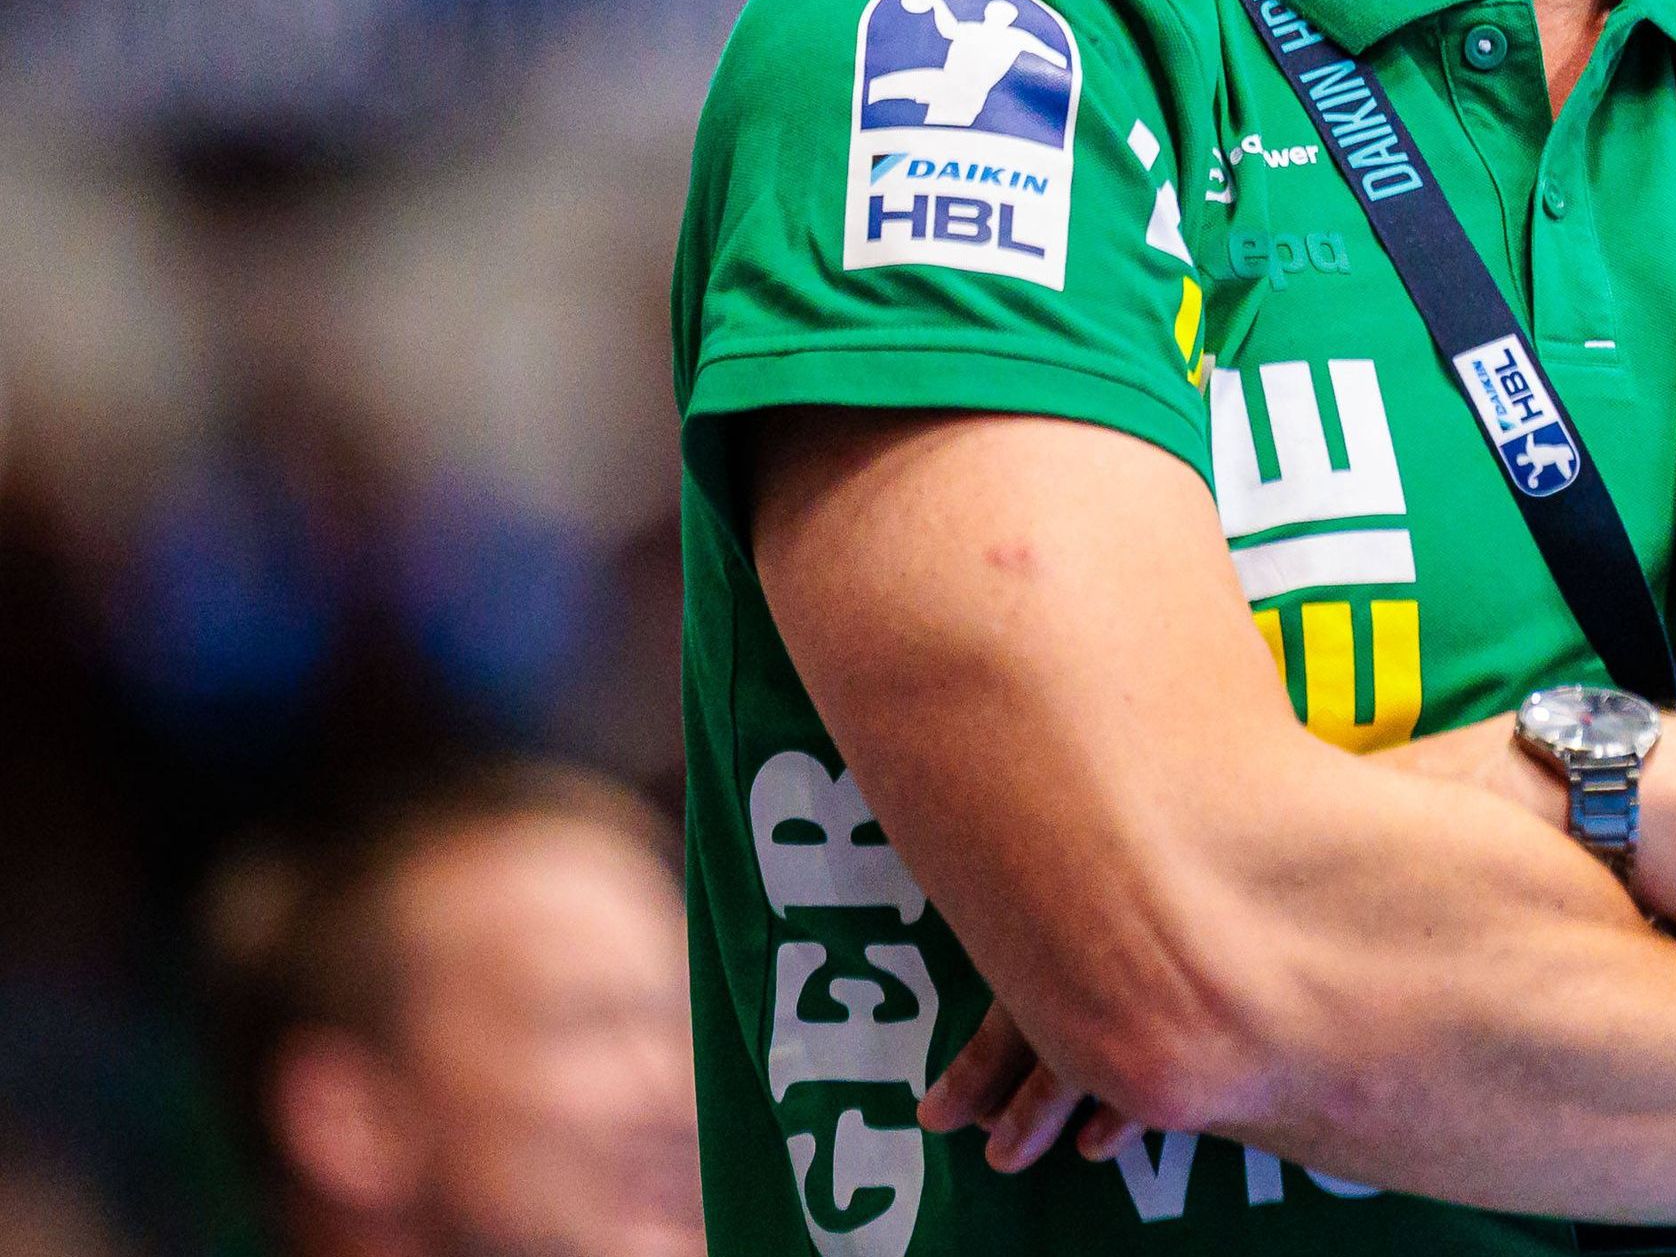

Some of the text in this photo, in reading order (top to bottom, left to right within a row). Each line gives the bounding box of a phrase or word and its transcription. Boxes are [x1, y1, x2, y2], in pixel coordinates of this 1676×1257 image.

[1299, 58, 1424, 202] DAIKIN
[906, 159, 1049, 195] DAIKIN
[867, 194, 1046, 260] HBL
[1494, 347, 1544, 424] HBL
